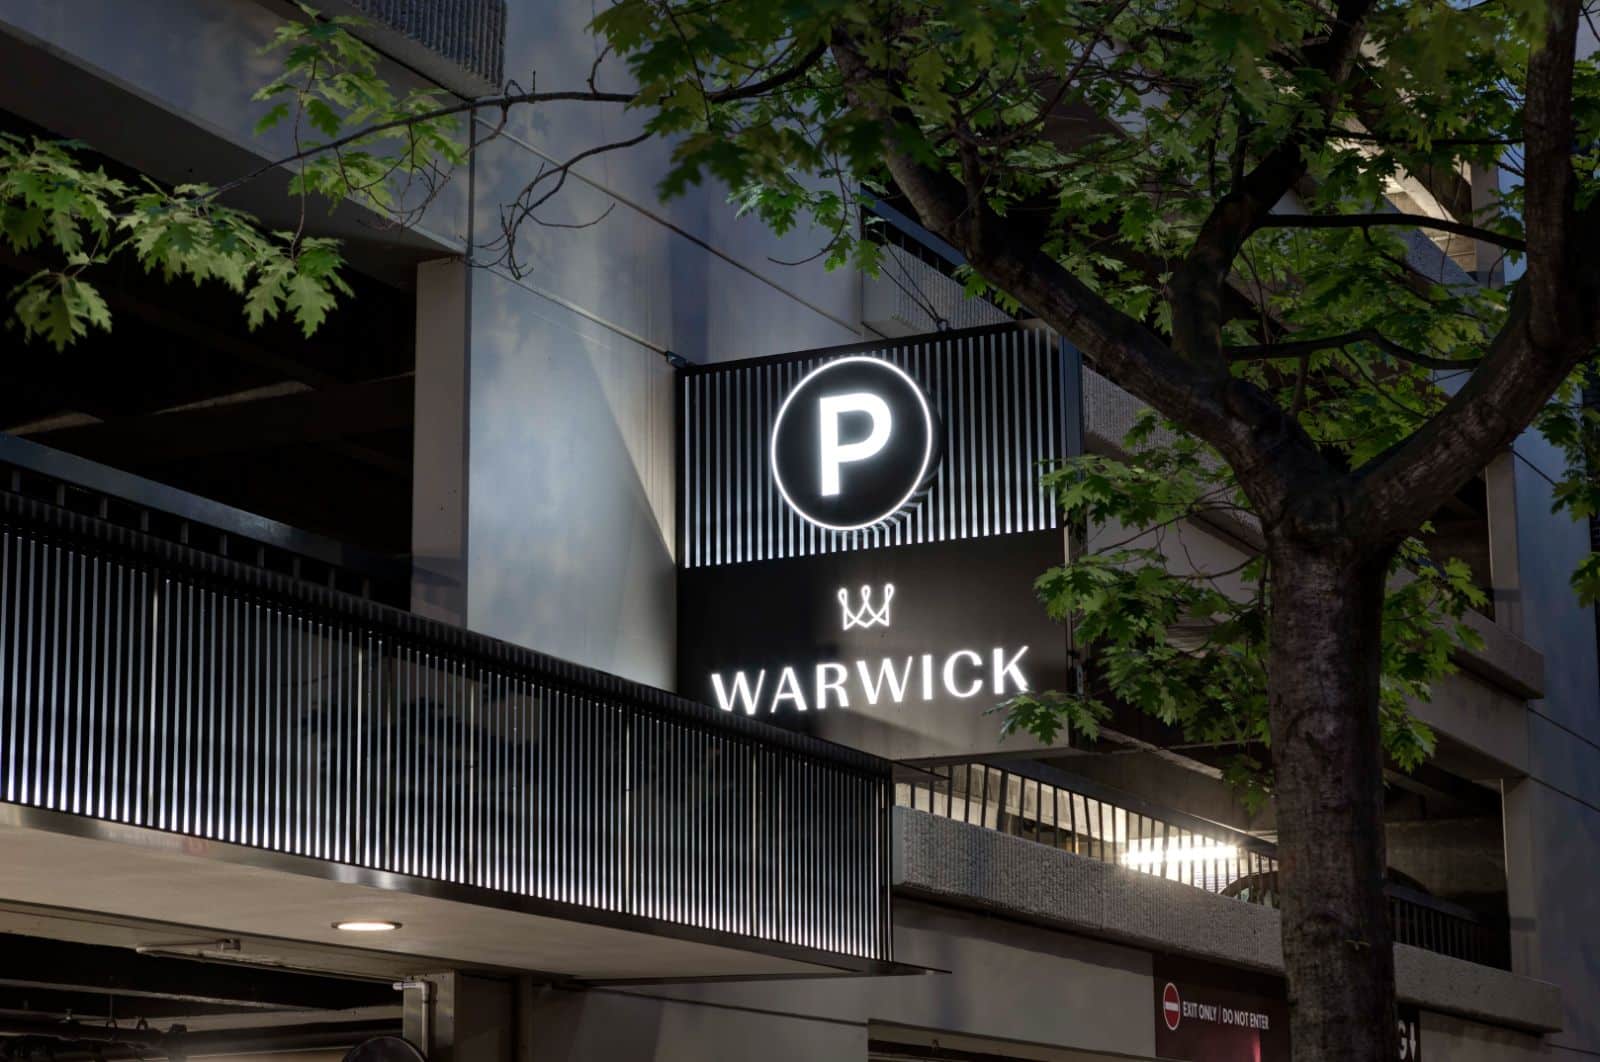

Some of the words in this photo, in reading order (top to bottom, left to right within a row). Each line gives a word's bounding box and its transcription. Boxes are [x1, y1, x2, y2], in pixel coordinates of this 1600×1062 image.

[819, 392, 893, 498] P
[710, 645, 1030, 715] WARWICK
[1183, 1001, 1198, 1018] EXIT
[1199, 1003, 1217, 1022] ONLY
[1222, 1007, 1233, 1024] DO
[1234, 1009, 1249, 1027] NOT
[1249, 1012, 1270, 1030] ENTER
